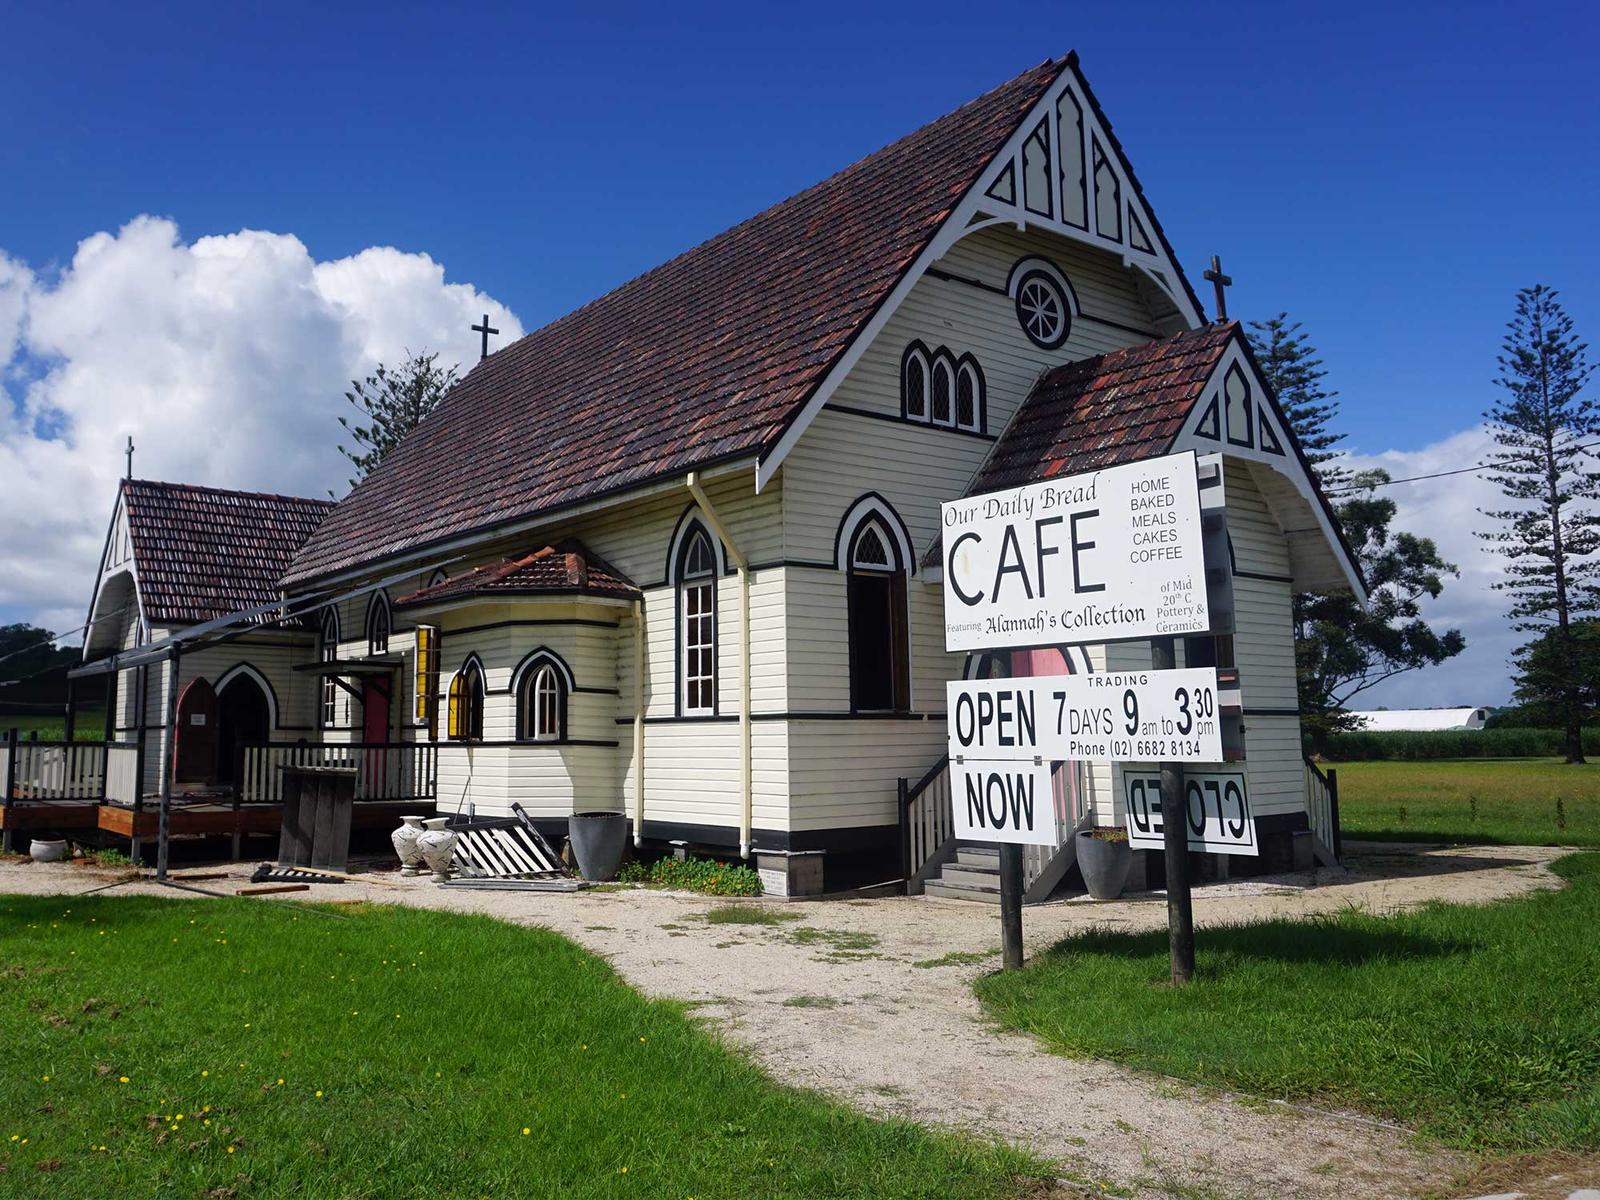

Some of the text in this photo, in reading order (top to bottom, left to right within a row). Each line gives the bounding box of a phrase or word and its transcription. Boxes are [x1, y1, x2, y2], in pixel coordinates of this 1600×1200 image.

[1131, 476, 1170, 494] HOME
[944, 471, 1101, 527] Our Daily Bread
[1130, 493, 1175, 511] BAKED
[1132, 511, 1177, 528] MEALS
[1132, 528, 1178, 546] CAKES
[948, 508, 1106, 607] CAFE
[1130, 545, 1183, 564] COFFEE
[1160, 578, 1193, 593] of Mid
[1162, 592, 1192, 606] 20th C
[946, 602, 1146, 635] Featuring Alannah's Collection
[1156, 603, 1205, 618] Pottery &
[1155, 621, 1203, 633] Ceramics
[1087, 674, 1149, 688] TRADING
[955, 689, 1037, 748] OPEN
[1052, 691, 1067, 736] 7
[1069, 707, 1114, 736] DAYS
[1123, 688, 1140, 737] 9
[1141, 721, 1159, 736] am
[1161, 714, 1175, 736] to
[1196, 720, 1215, 740] pm
[1069, 738, 1201, 759] Phone (02) 6682 8134
[964, 772, 1035, 832] NOW
[1130, 778, 1246, 840] CLOED
